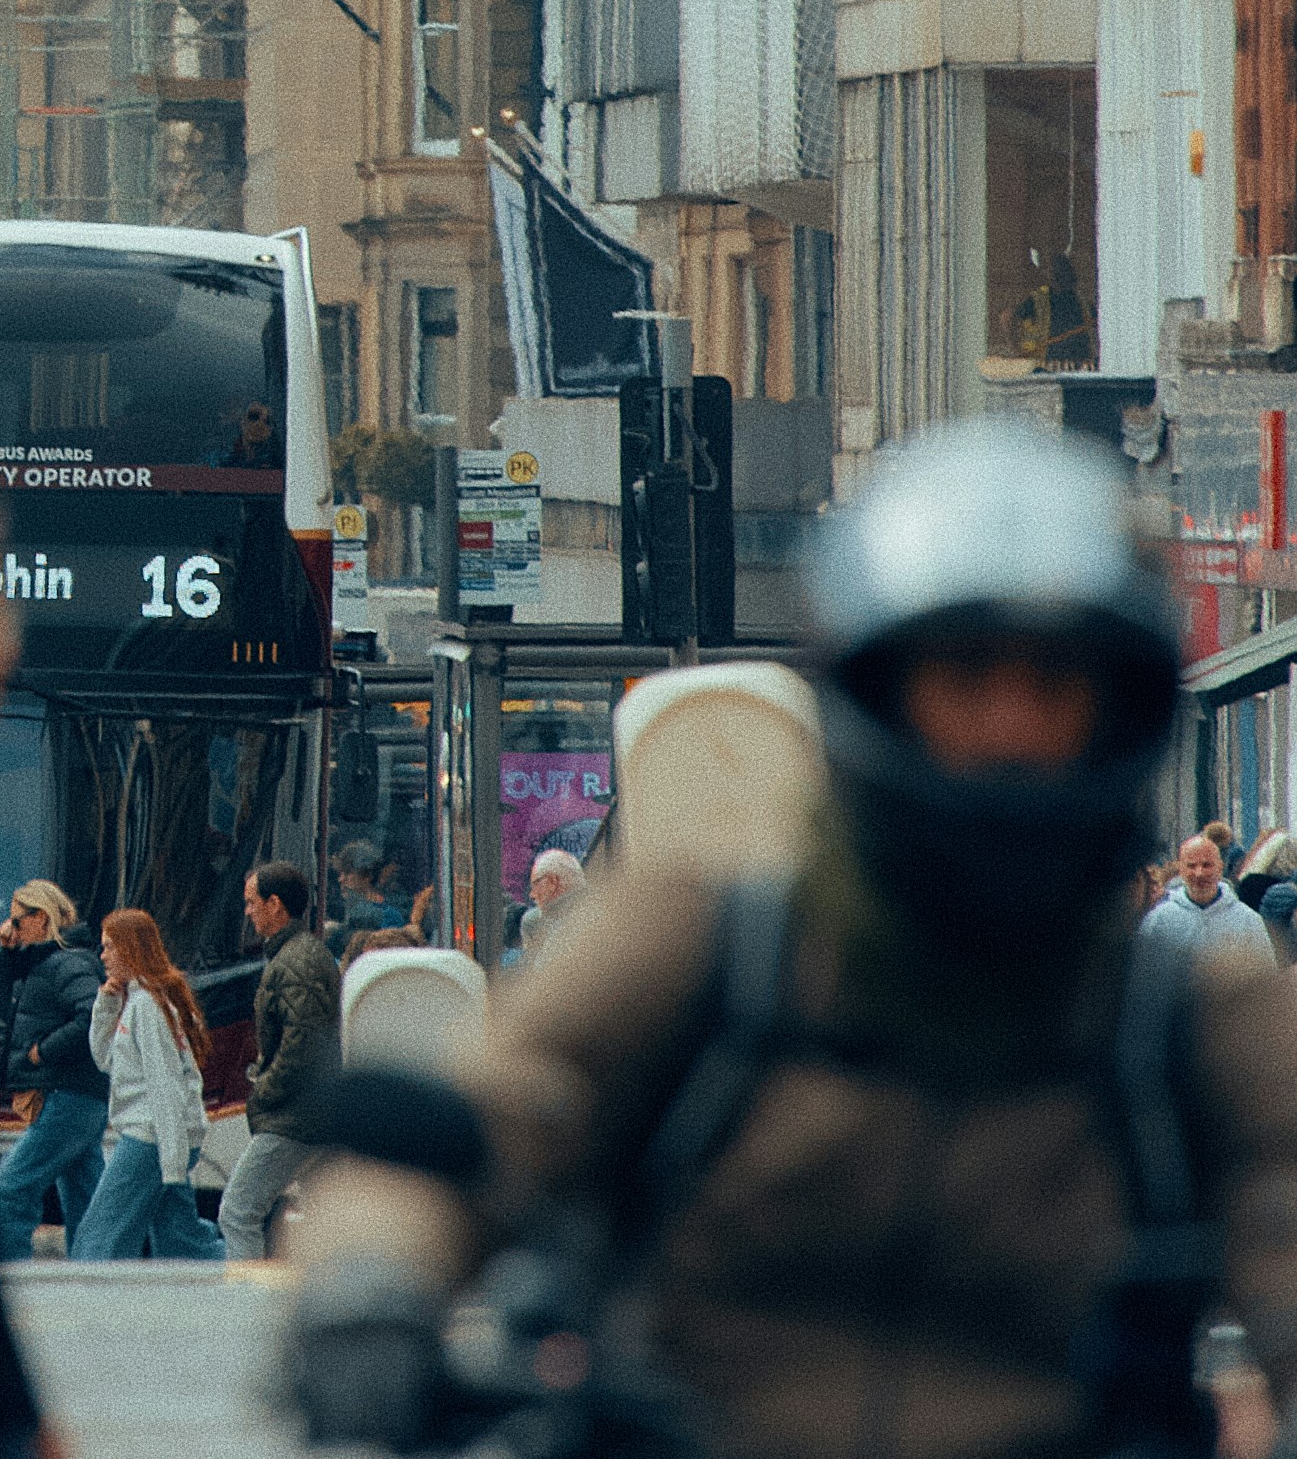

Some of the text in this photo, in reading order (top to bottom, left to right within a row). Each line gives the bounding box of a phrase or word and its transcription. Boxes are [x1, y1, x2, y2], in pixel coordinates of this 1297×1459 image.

[27, 446, 94, 463] AWARDS
[23, 467, 154, 488] OPERATOR
[141, 554, 221, 619] 16
